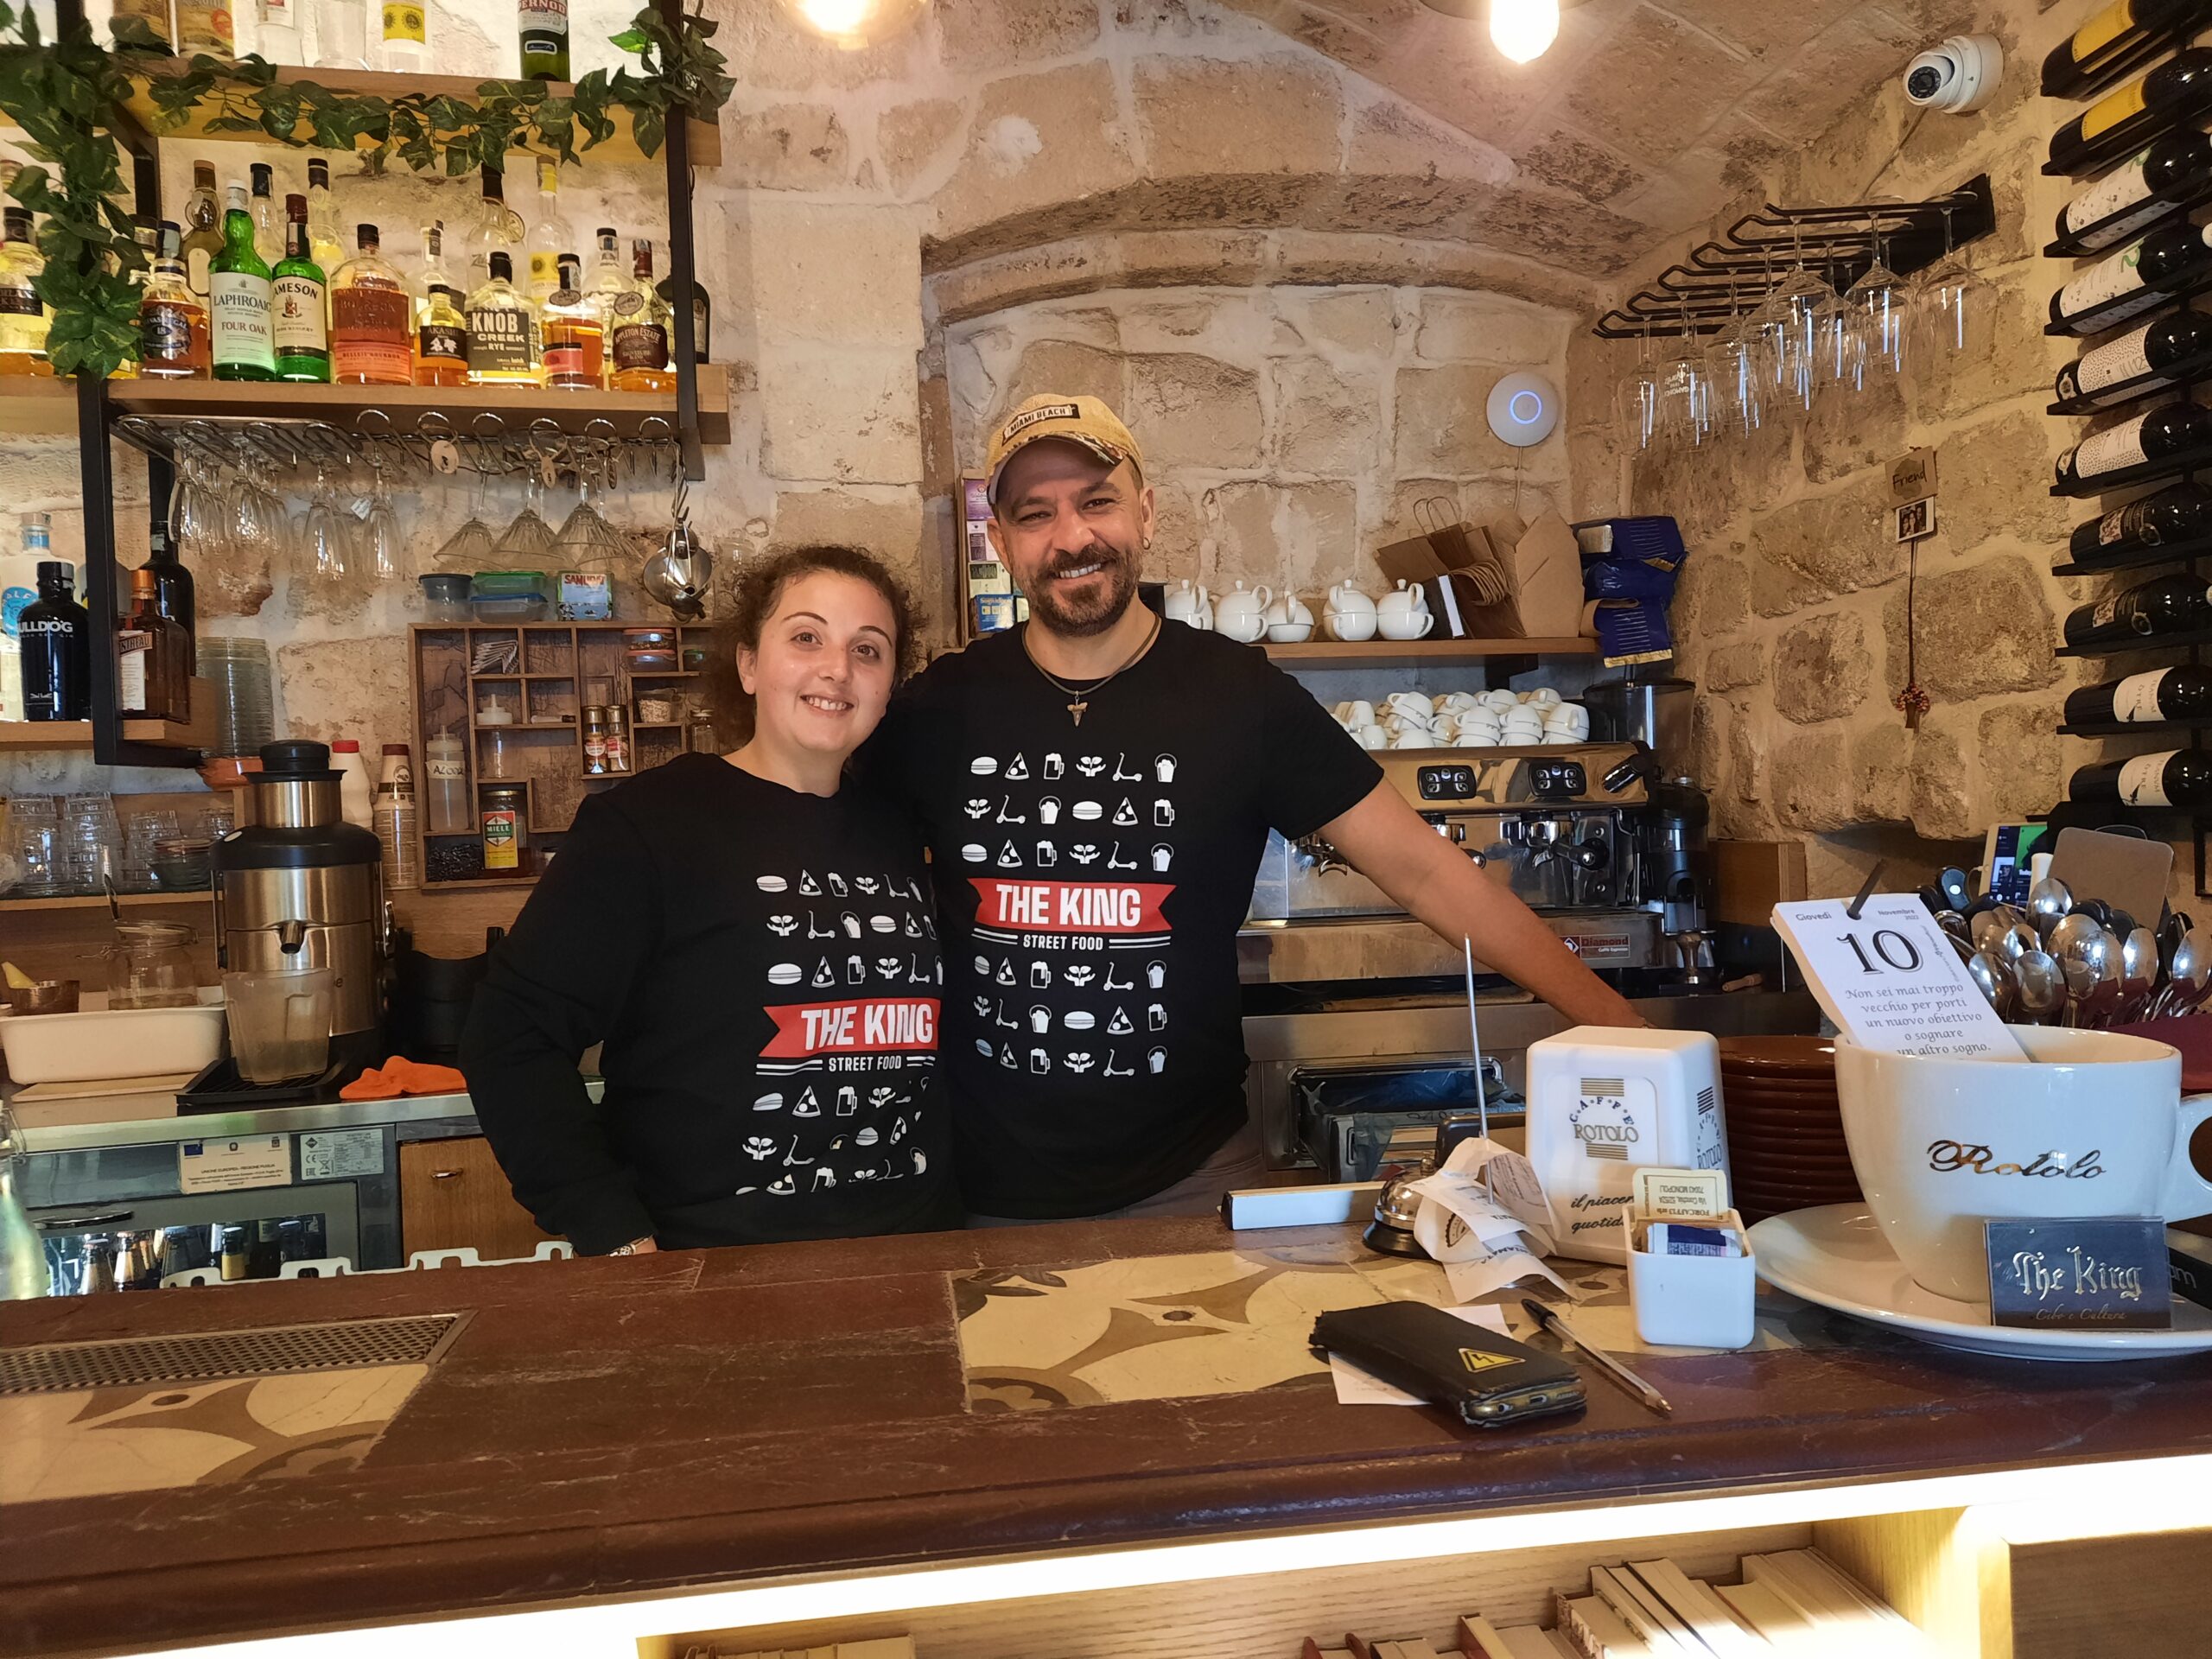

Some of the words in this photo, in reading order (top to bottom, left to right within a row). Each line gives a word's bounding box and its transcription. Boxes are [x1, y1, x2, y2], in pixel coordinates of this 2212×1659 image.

[221, 321, 247, 332] FOUR
[251, 323, 268, 336] OAK
[472, 313, 518, 333] KNOB
[615, 327, 639, 345] APPLETON
[639, 327, 661, 344] ESTATE
[1010, 415, 1034, 433] MIAMI
[1037, 408, 1065, 418] BEACH
[1892, 459, 1928, 490] Friend
[19, 620, 73, 632] ULLDOG
[996, 884, 1051, 925] THE
[1058, 887, 1141, 927] KING
[1022, 934, 1069, 950] STREET
[1071, 935, 1104, 951] FOOD
[1582, 937, 1628, 947] Diamond
[1836, 929, 1924, 976] 10
[1845, 989, 1873, 1000] Non
[1876, 988, 1893, 997] sei
[1896, 985, 1921, 995] mai
[1923, 982, 1964, 999] troppo
[1861, 1001, 1908, 1014] vecchio
[1911, 1001, 1932, 1014] per
[1936, 997, 1967, 1013] porti
[801, 1006, 857, 1051] THE
[863, 1004, 933, 1045] KING
[1885, 1016, 1924, 1026] nuovo
[1928, 1012, 1982, 1024] obiettivo
[1905, 1032, 1912, 1040] o
[1915, 1029, 1964, 1044] sognare
[1897, 1047, 1916, 1056] un
[1918, 1044, 1949, 1056] altro
[1952, 1044, 1991, 1056] sogno.
[828, 1057, 873, 1072] STREET
[876, 1055, 902, 1071] FOOD
[1573, 1123, 1639, 1142] ROTOLO
[1927, 1140, 2107, 1179] Rotolo
[1571, 1194, 1588, 1208] il
[1582, 1195, 1635, 1212] piacer
[1572, 1215, 1624, 1235] quotid
[2012, 1251, 2065, 1300] The
[2067, 1246, 2143, 1301] King
